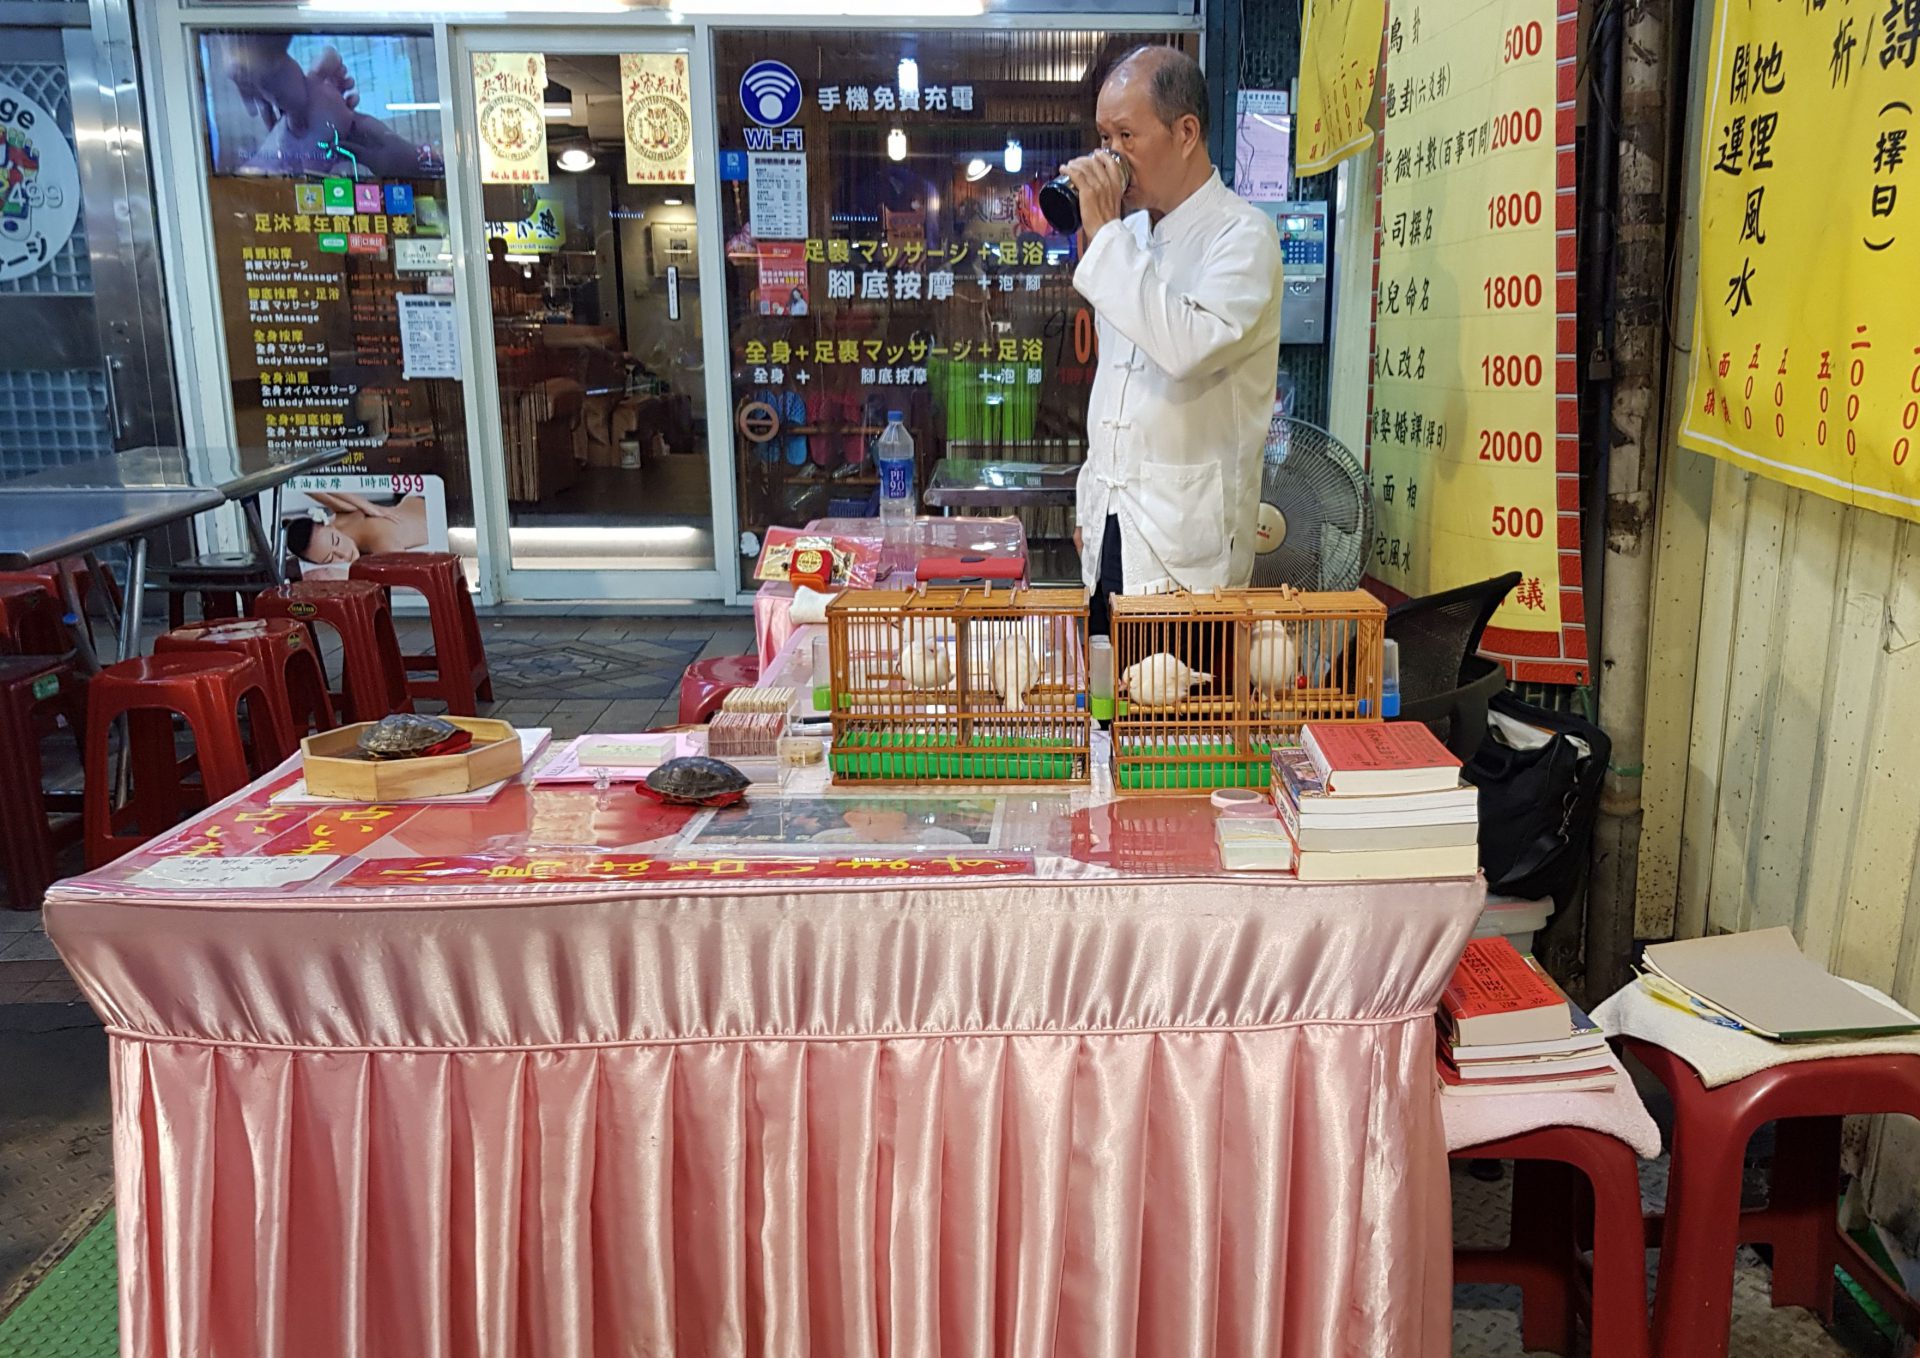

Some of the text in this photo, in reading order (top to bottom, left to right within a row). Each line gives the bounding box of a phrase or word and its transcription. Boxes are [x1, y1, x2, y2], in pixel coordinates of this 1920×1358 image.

[1505, 20, 1542, 63] 500
[818, 85, 975, 112] 手機免費充電
[743, 127, 804, 151] Wi-Fi
[1491, 108, 1542, 151] 2000
[1722, 41, 1786, 317] 地理風水
[1487, 190, 1542, 230] 1800
[246, 271, 291, 282] Shoulder
[293, 271, 339, 283] Massage
[828, 269, 954, 300] 腳底按摩
[1483, 274, 1542, 310] 1800
[250, 313, 320, 324] Foot Massage
[253, 329, 304, 343] 全身按摩
[256, 355, 329, 367] Body Massage
[1481, 354, 1543, 387] 1800
[753, 367, 784, 385] 全身
[262, 397, 277, 407] Oil
[279, 397, 304, 408] Body
[306, 397, 350, 408] Massage
[294, 439, 339, 448] Meridian
[340, 439, 384, 449] Massage
[1479, 430, 1543, 463] 2000
[391, 473, 424, 493] 999
[1492, 506, 1544, 539] 500
